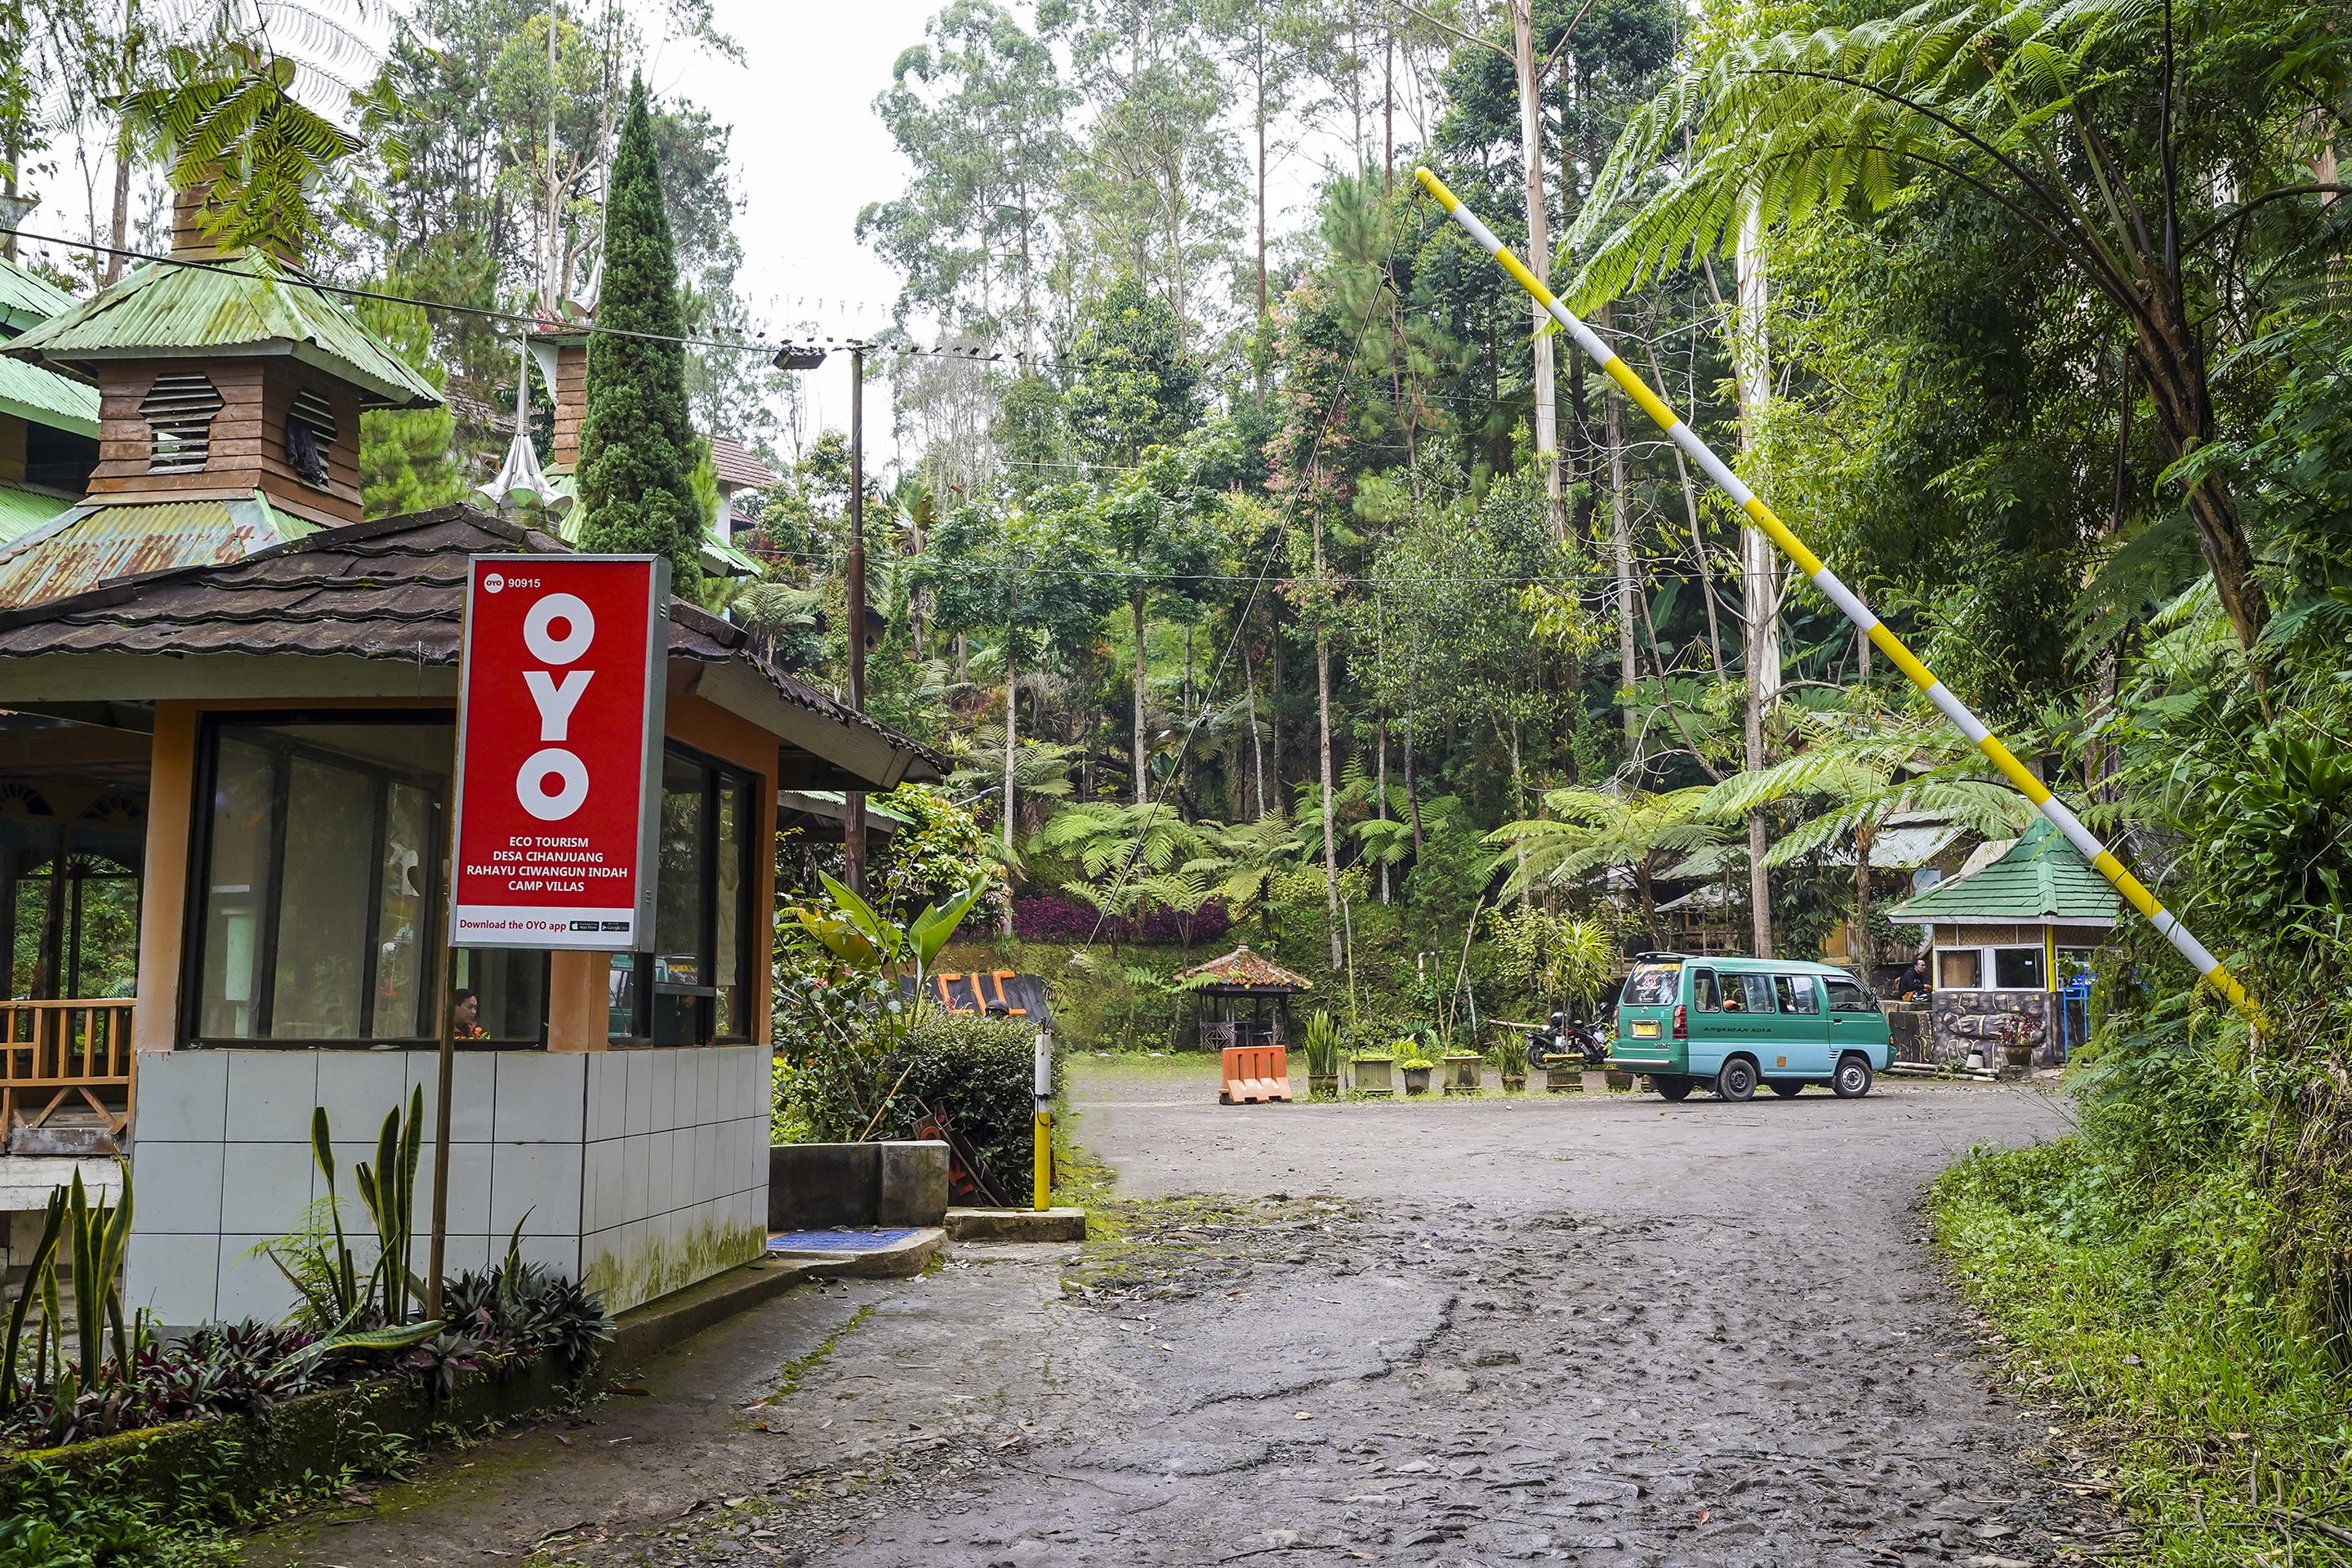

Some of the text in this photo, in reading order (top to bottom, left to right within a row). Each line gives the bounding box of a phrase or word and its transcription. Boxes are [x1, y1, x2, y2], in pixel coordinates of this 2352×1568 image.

[508, 578, 541, 588] 90915
[516, 593, 595, 821] OYO
[509, 836, 589, 848] ECO TOURISM
[492, 850, 604, 863] DESA CIHANJUANG
[466, 865, 628, 878] RAHAYU CIWANGUN INDAH
[508, 880, 585, 892] CAMP VILLAS
[460, 919, 567, 933] Download the OYO app
